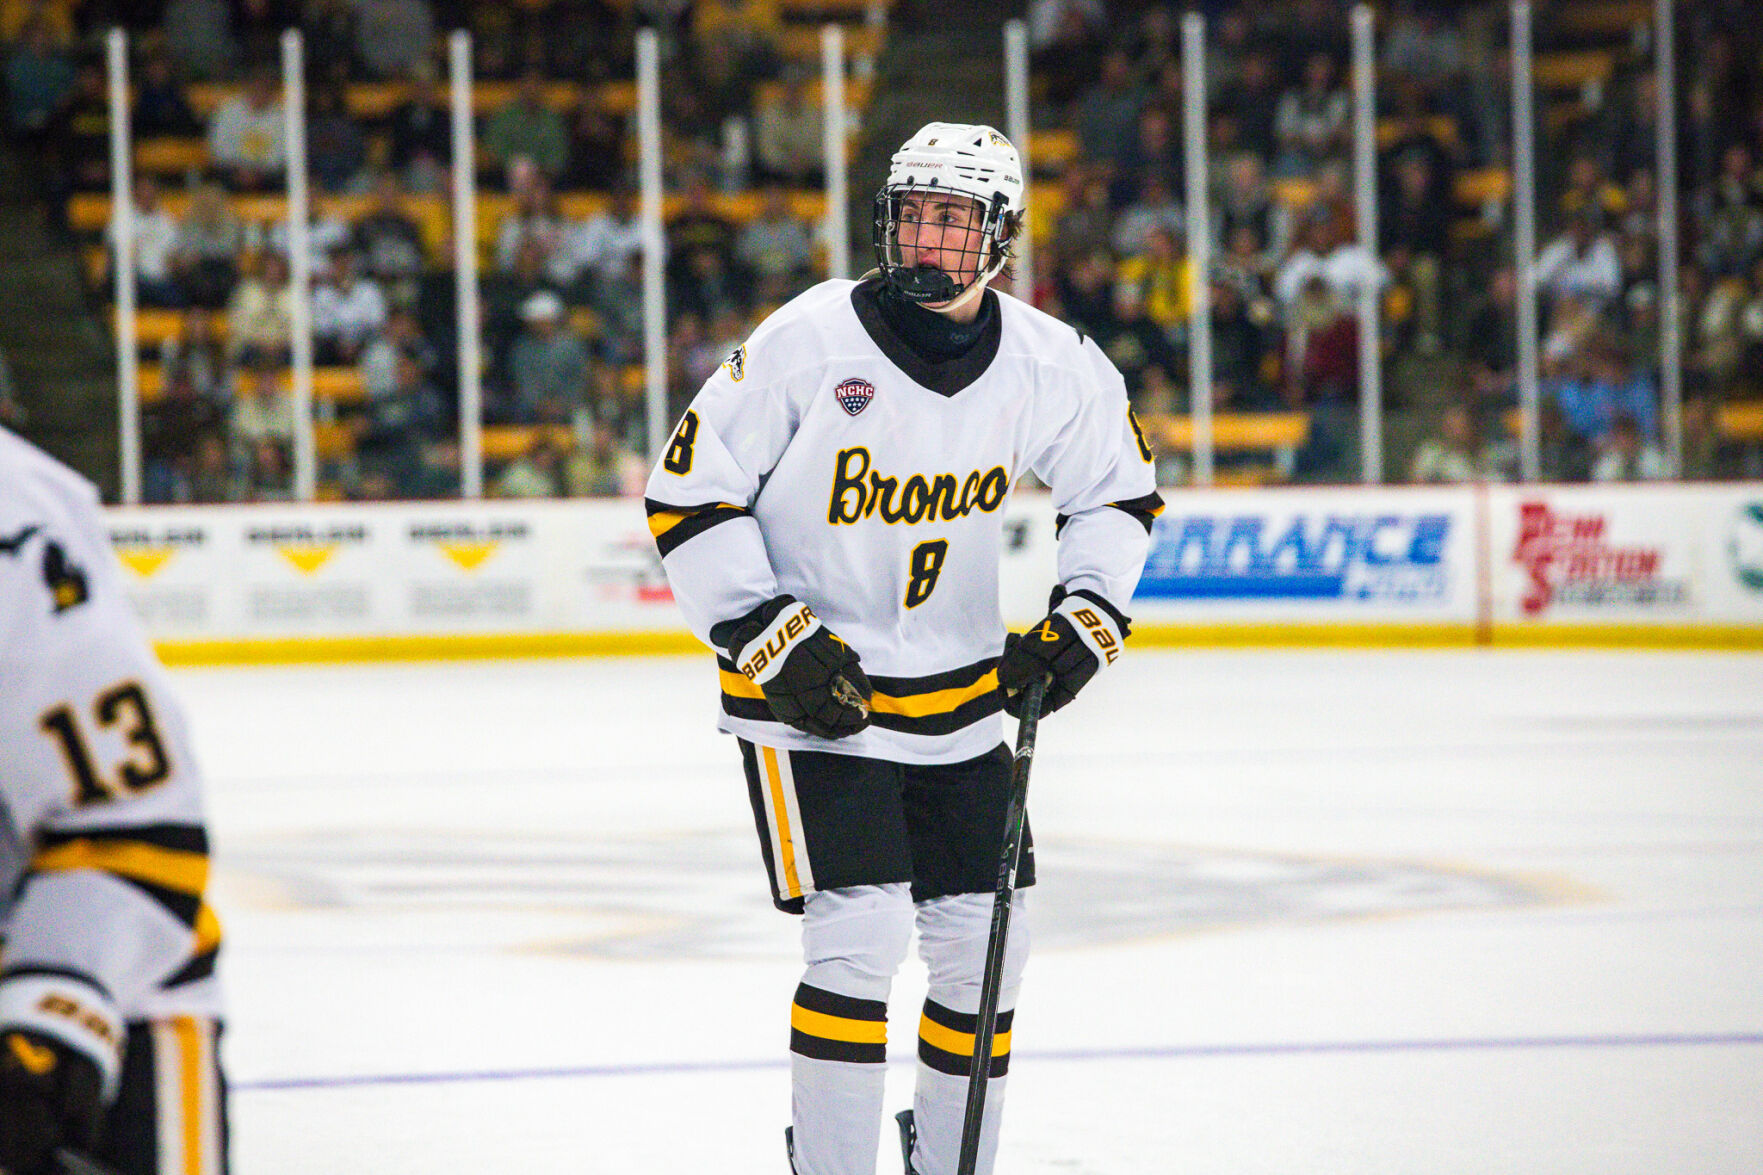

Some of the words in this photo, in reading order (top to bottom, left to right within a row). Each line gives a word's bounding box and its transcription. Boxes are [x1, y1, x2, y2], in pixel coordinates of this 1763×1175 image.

[835, 384, 874, 399] NCHC
[663, 408, 700, 477] 8
[826, 445, 1009, 526] Bronco
[903, 537, 950, 610] 8
[740, 604, 818, 681] BAUER
[38, 679, 172, 806] 13
